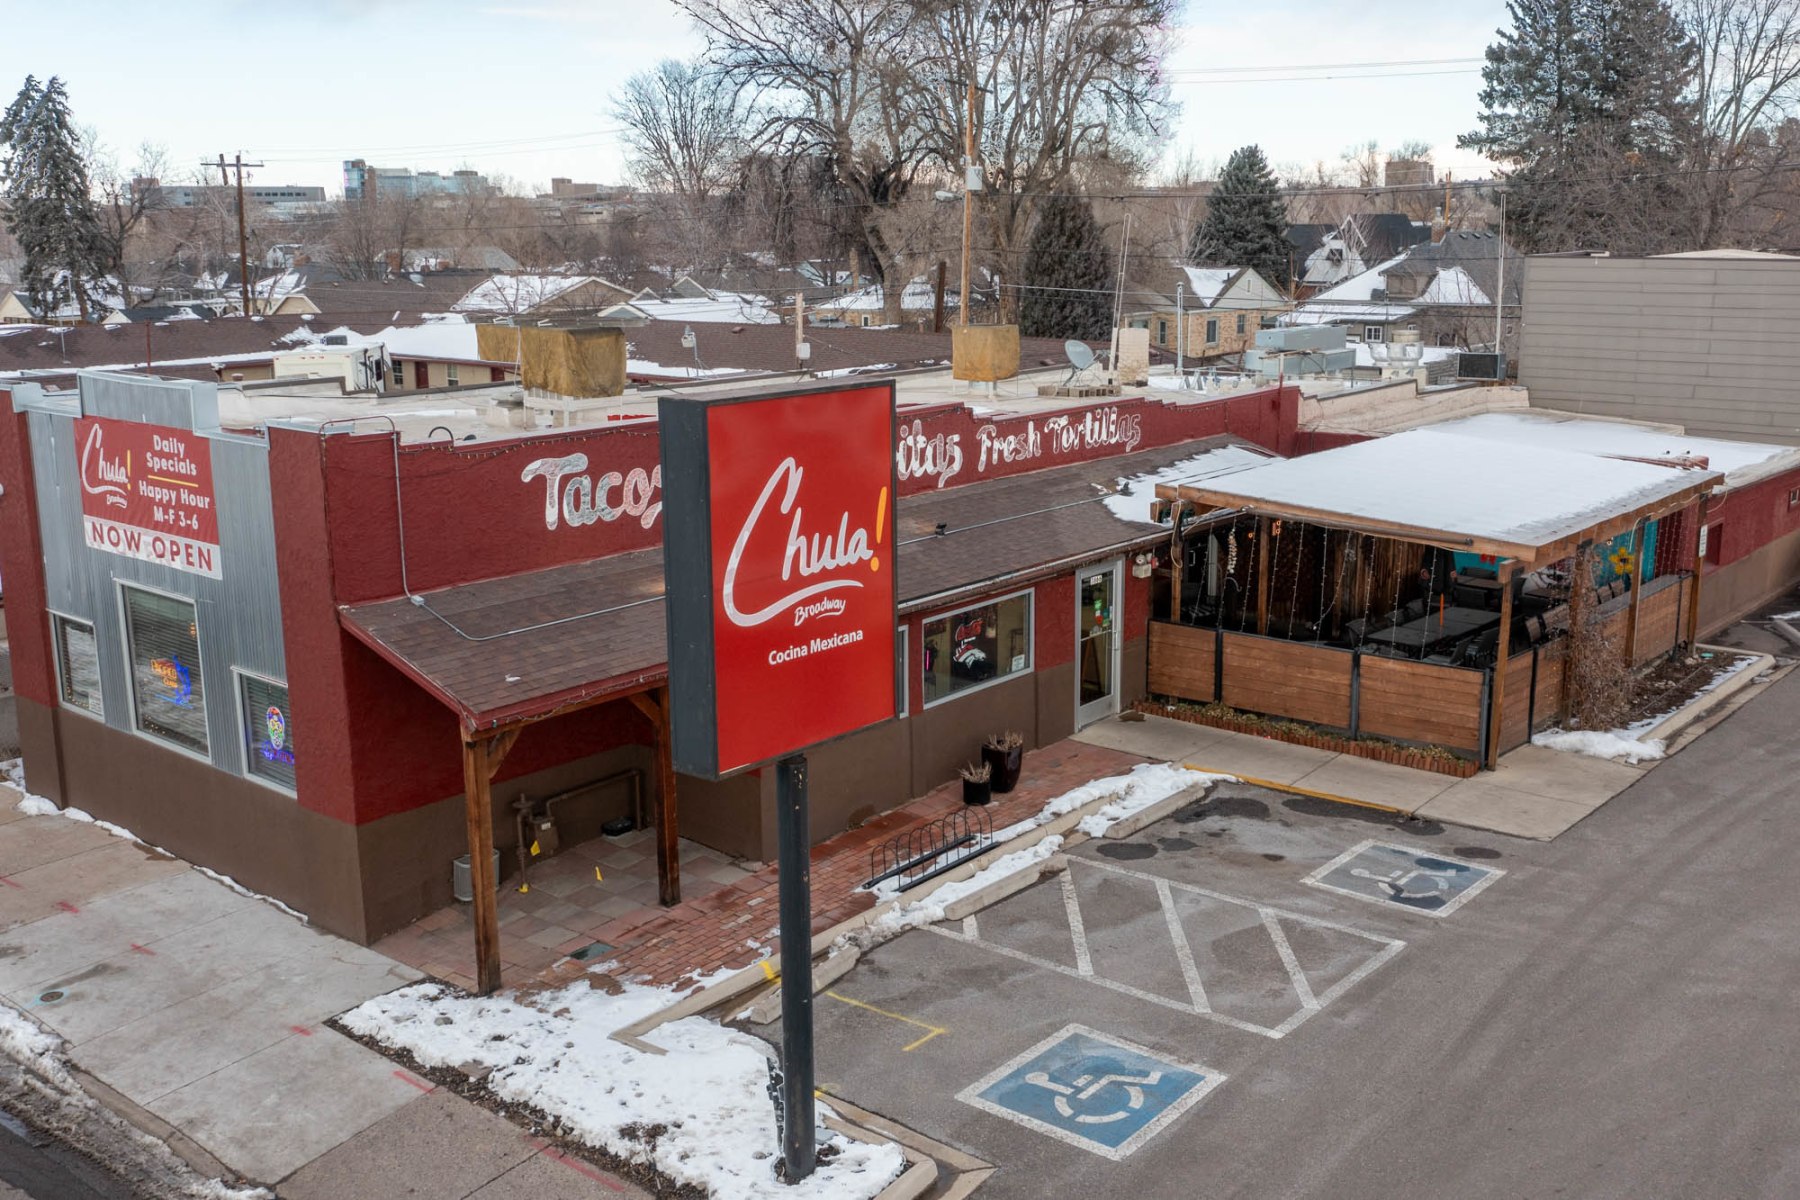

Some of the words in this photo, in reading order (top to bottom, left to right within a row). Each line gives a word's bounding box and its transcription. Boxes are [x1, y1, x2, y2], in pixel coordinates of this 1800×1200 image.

[152, 434, 185, 458] Daily
[976, 420, 1042, 473] Fresh
[1044, 406, 1141, 453] Tortillas
[81, 423, 131, 494] Chula!
[146, 451, 197, 475] Specials
[139, 480, 177, 505] Happy
[180, 489, 210, 509] Hour
[153, 506, 175, 524] M-F
[178, 511, 199, 530] 3-6
[91, 521, 142, 553] NOW
[152, 536, 212, 572] OPEN
[723, 456, 888, 627] Chula!
[794, 597, 846, 627] Broadway
[768, 644, 808, 666] Cocina
[810, 629, 864, 655] Mexicana
